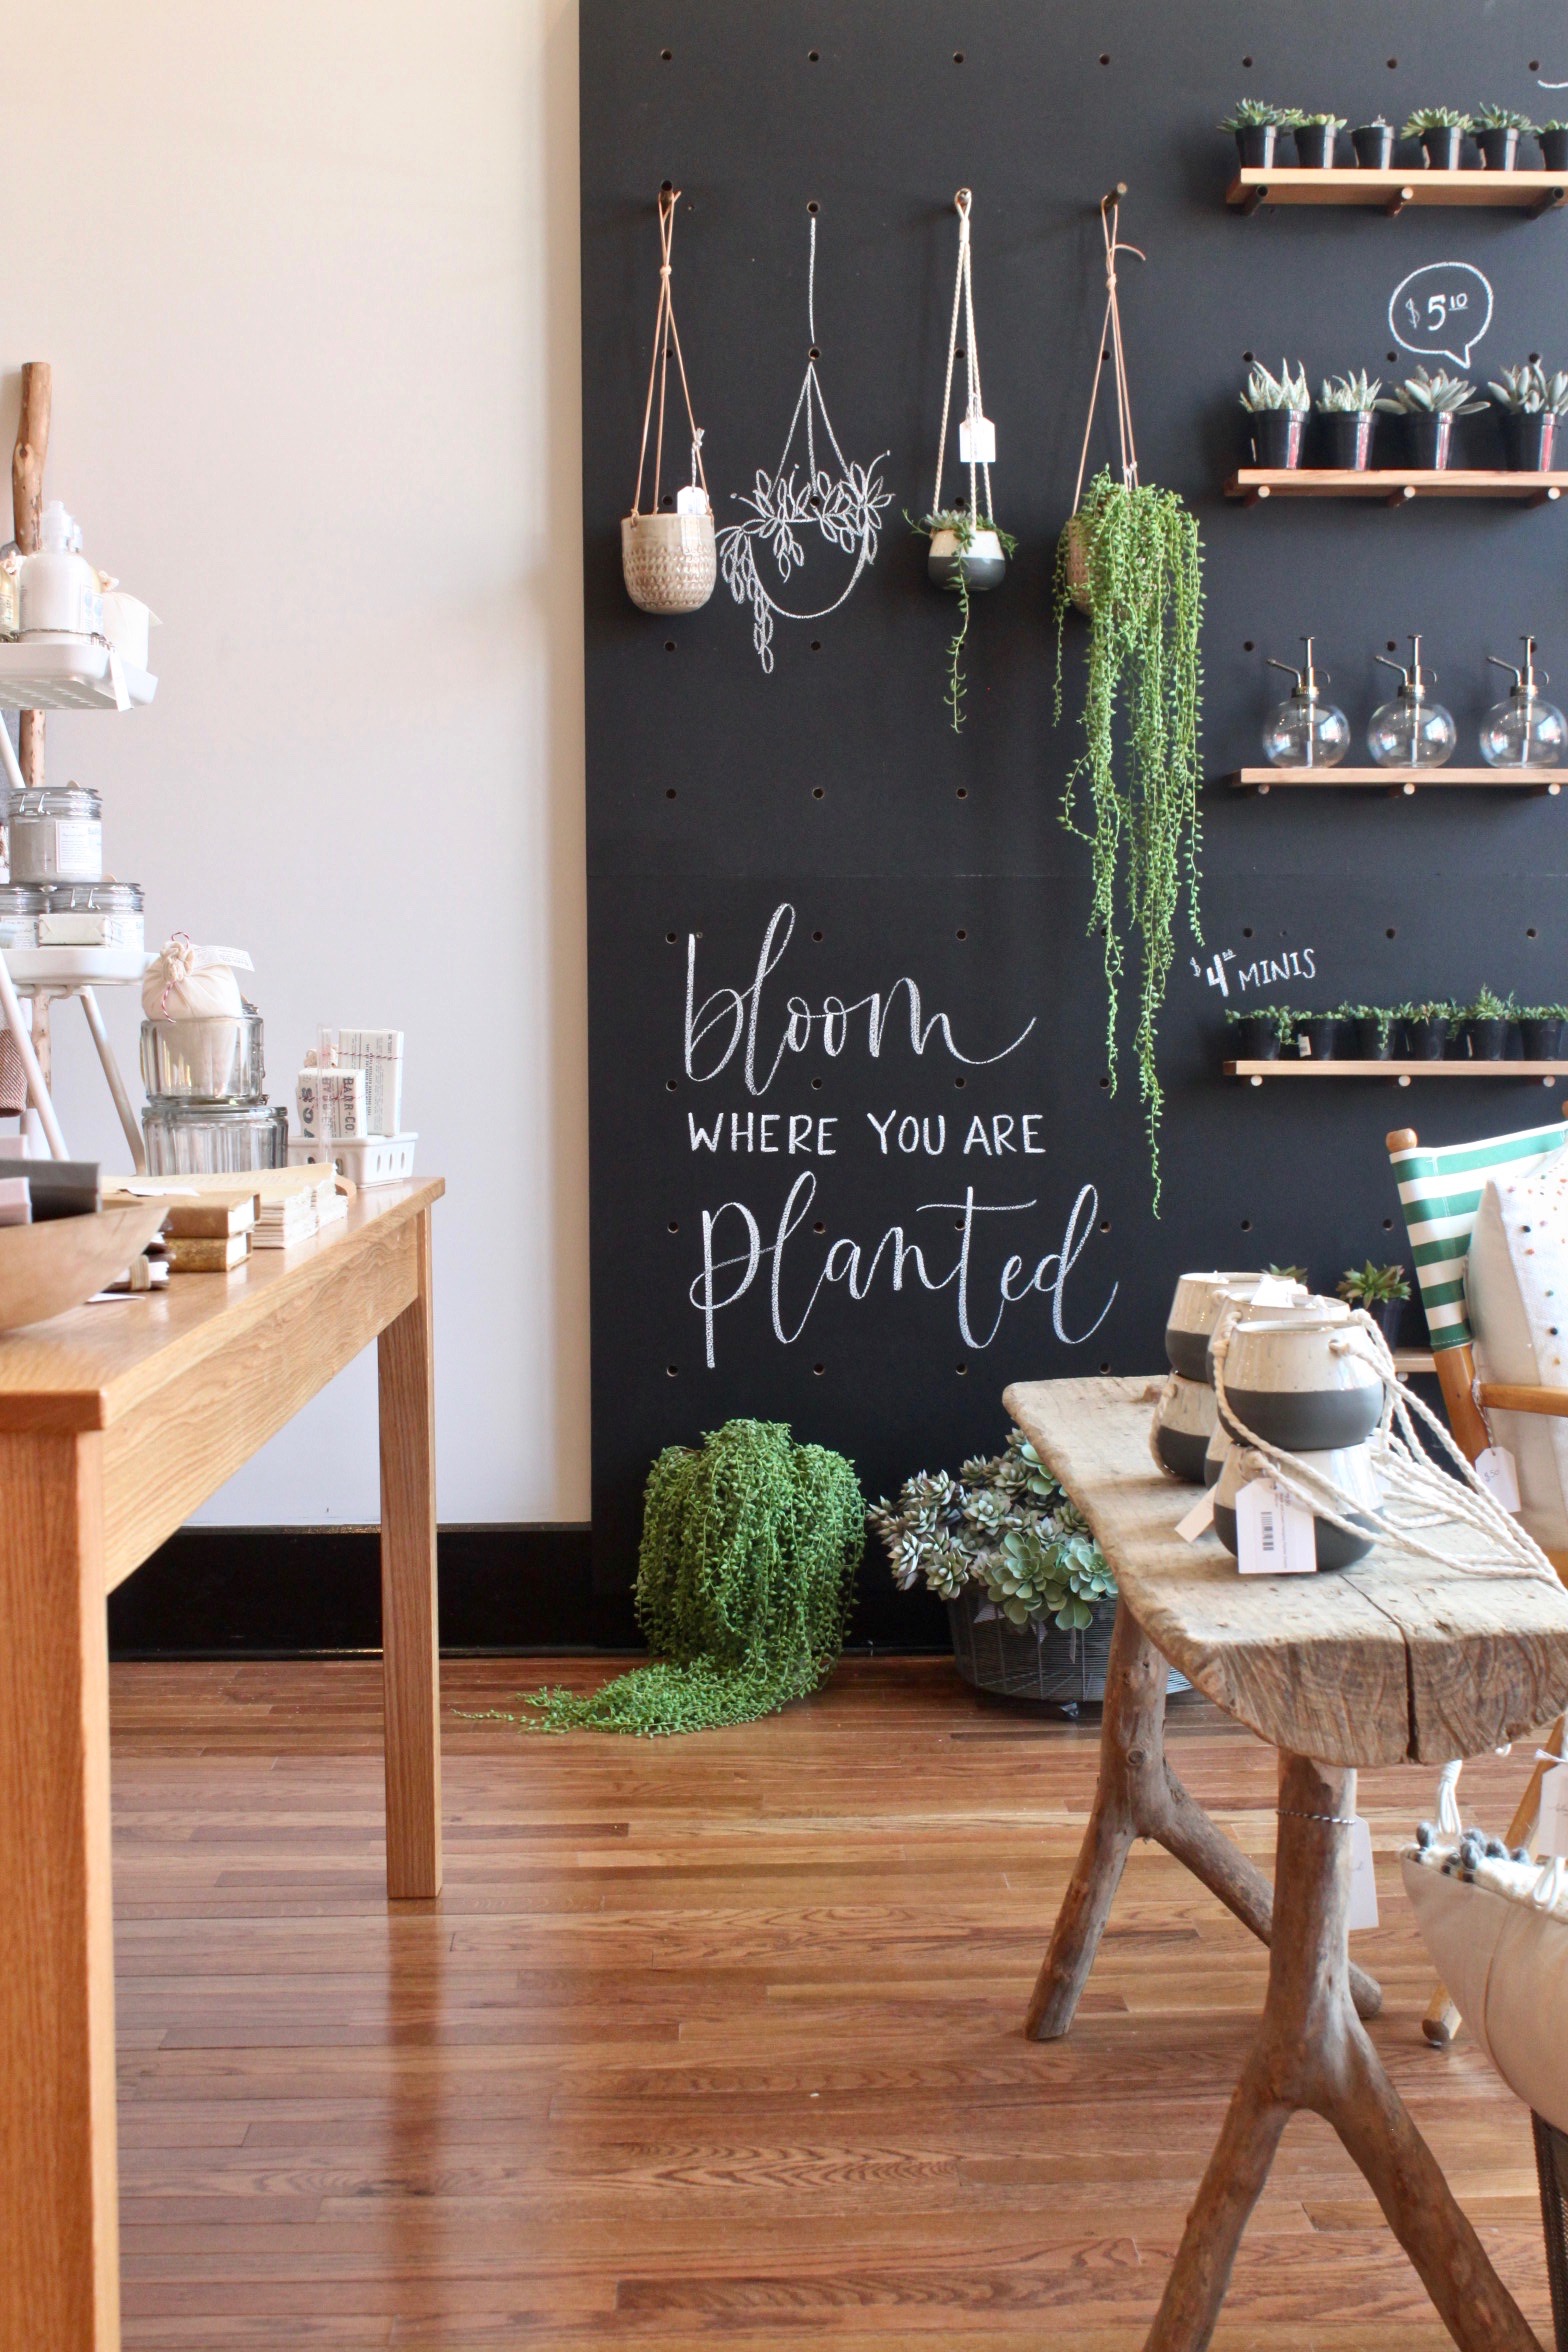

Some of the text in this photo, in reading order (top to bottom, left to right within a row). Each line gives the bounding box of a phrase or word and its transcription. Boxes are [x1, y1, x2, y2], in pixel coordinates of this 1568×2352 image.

[684, 902, 1037, 1096] bloom
[1238, 947, 1316, 992] MINIS
[687, 1108, 1047, 1156] WHERE YOU ARE
[689, 1170, 1119, 1369] planted
